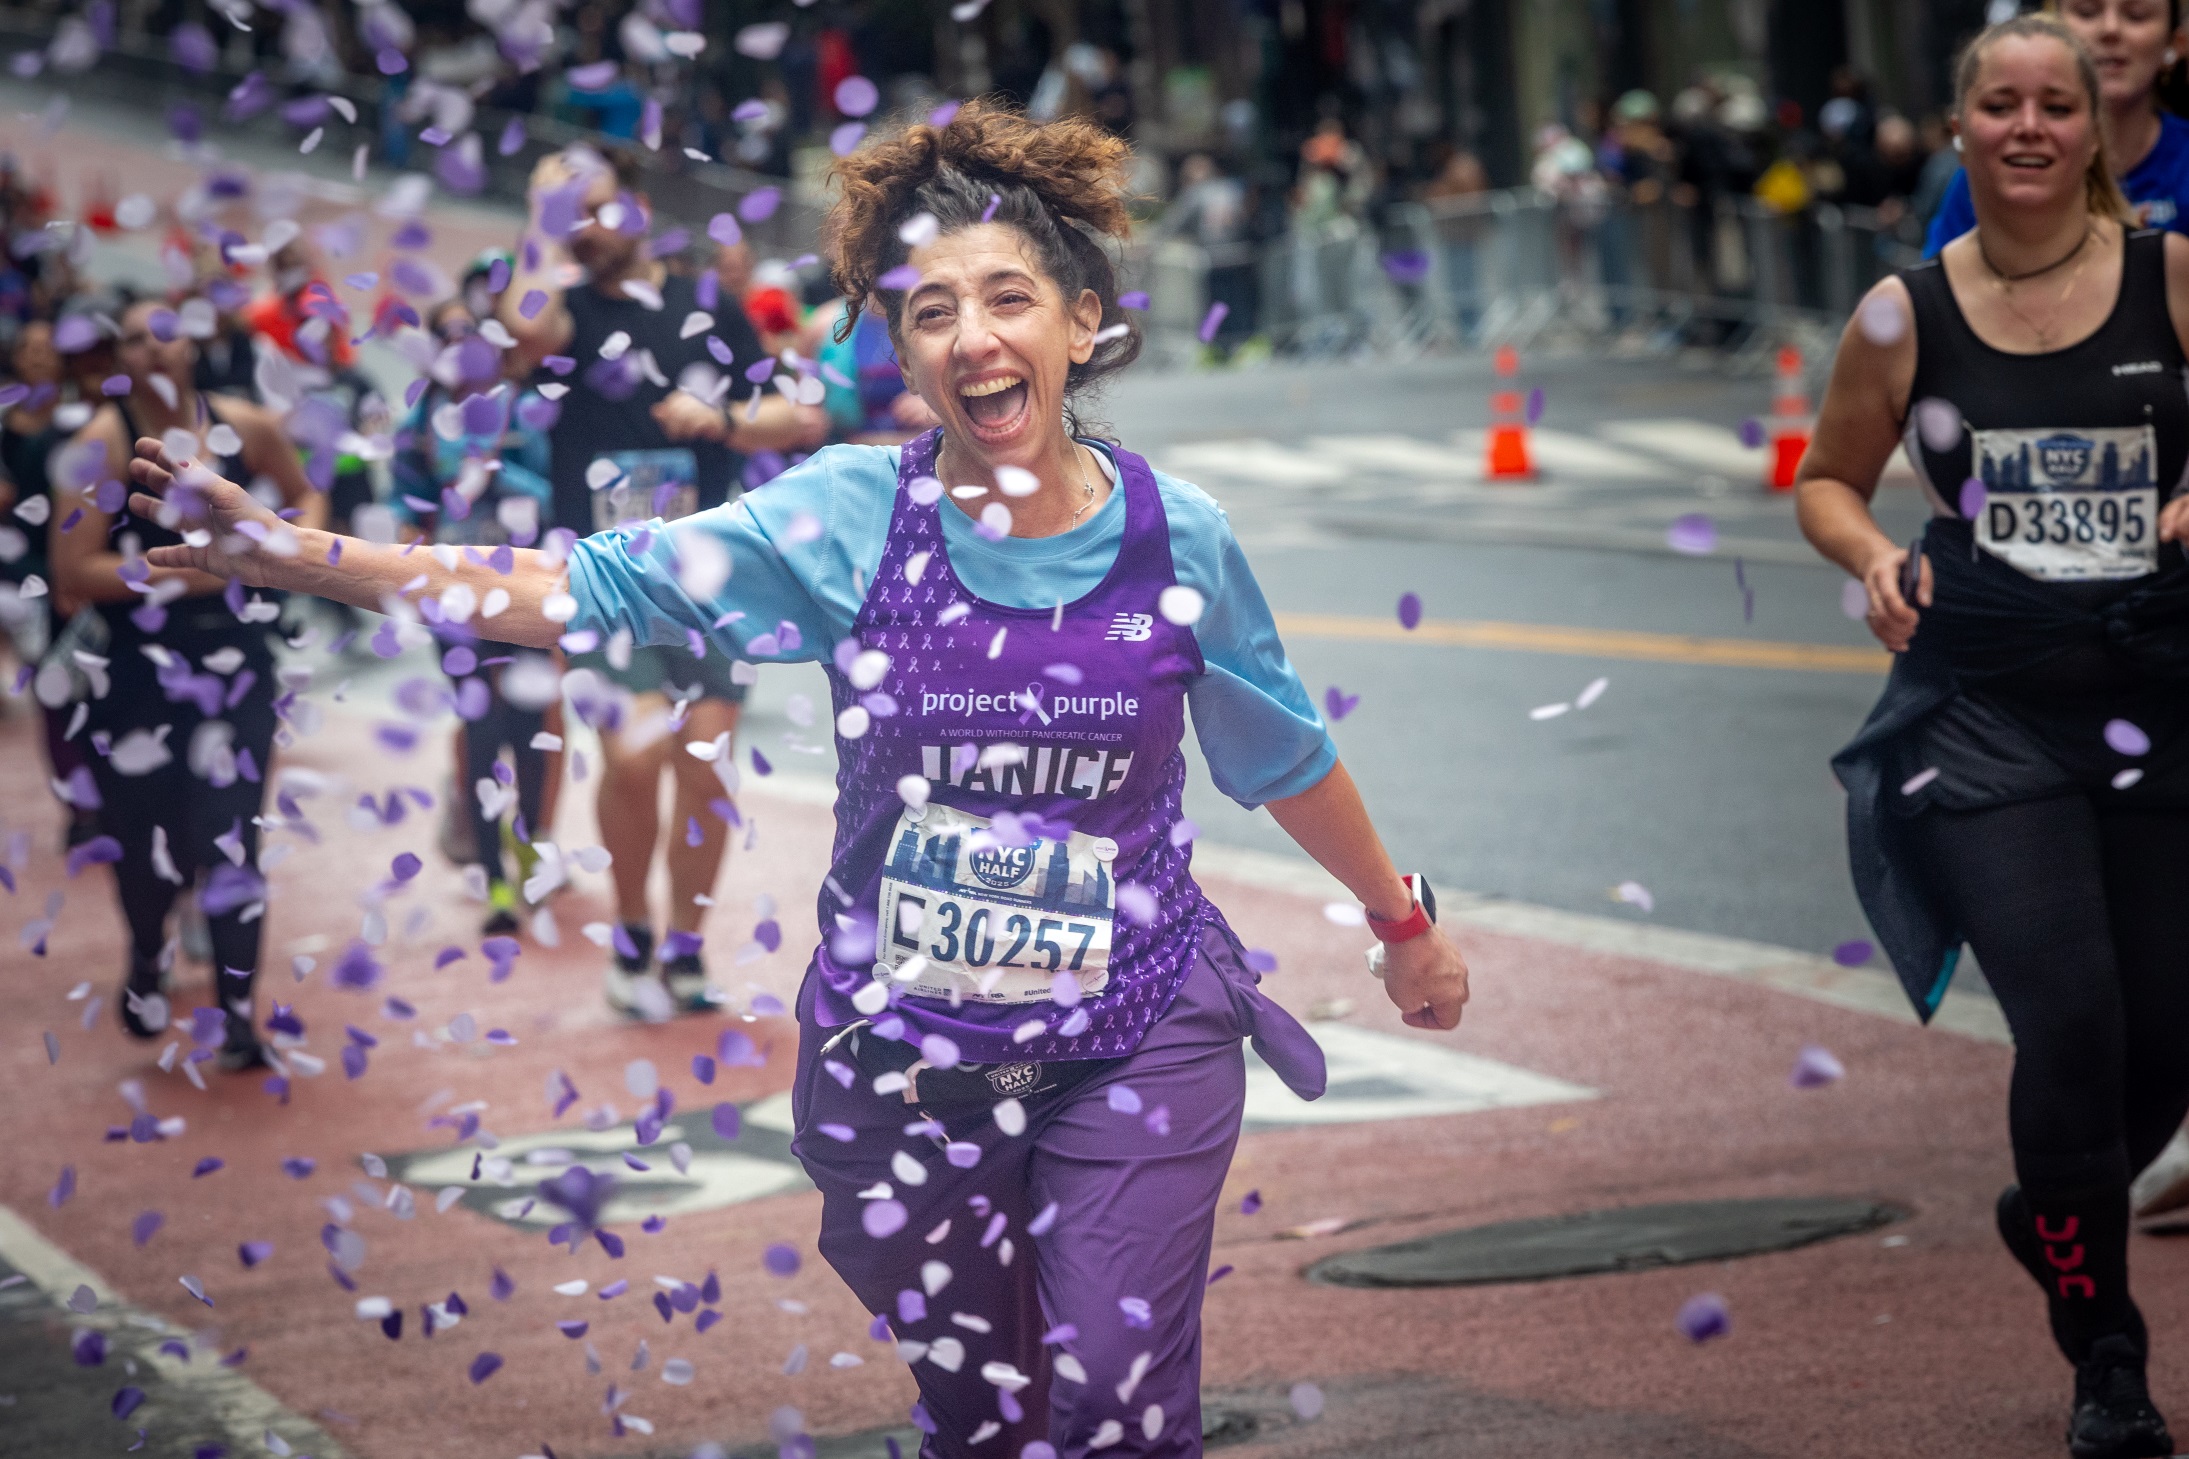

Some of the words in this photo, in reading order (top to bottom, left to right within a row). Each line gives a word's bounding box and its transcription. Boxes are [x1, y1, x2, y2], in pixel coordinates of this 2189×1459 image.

[2045, 449, 2084, 465] NYC
[1989, 496, 2147, 544] D33895
[922, 688, 1018, 717] project
[1054, 691, 1139, 721] purple
[939, 728, 947, 737] A
[949, 728, 984, 737] WORLD
[986, 729, 1030, 739] WITHOUT
[1032, 731, 1086, 742] PANCREATIC
[1088, 732, 1123, 742] CANCER
[925, 742, 1134, 800] JANICE
[978, 845, 1026, 866] NYC
[979, 861, 1020, 879] HALF
[985, 877, 1010, 888] 2025
[1000, 1065, 1034, 1087] NYC
[1004, 1075, 1033, 1092] HALF
